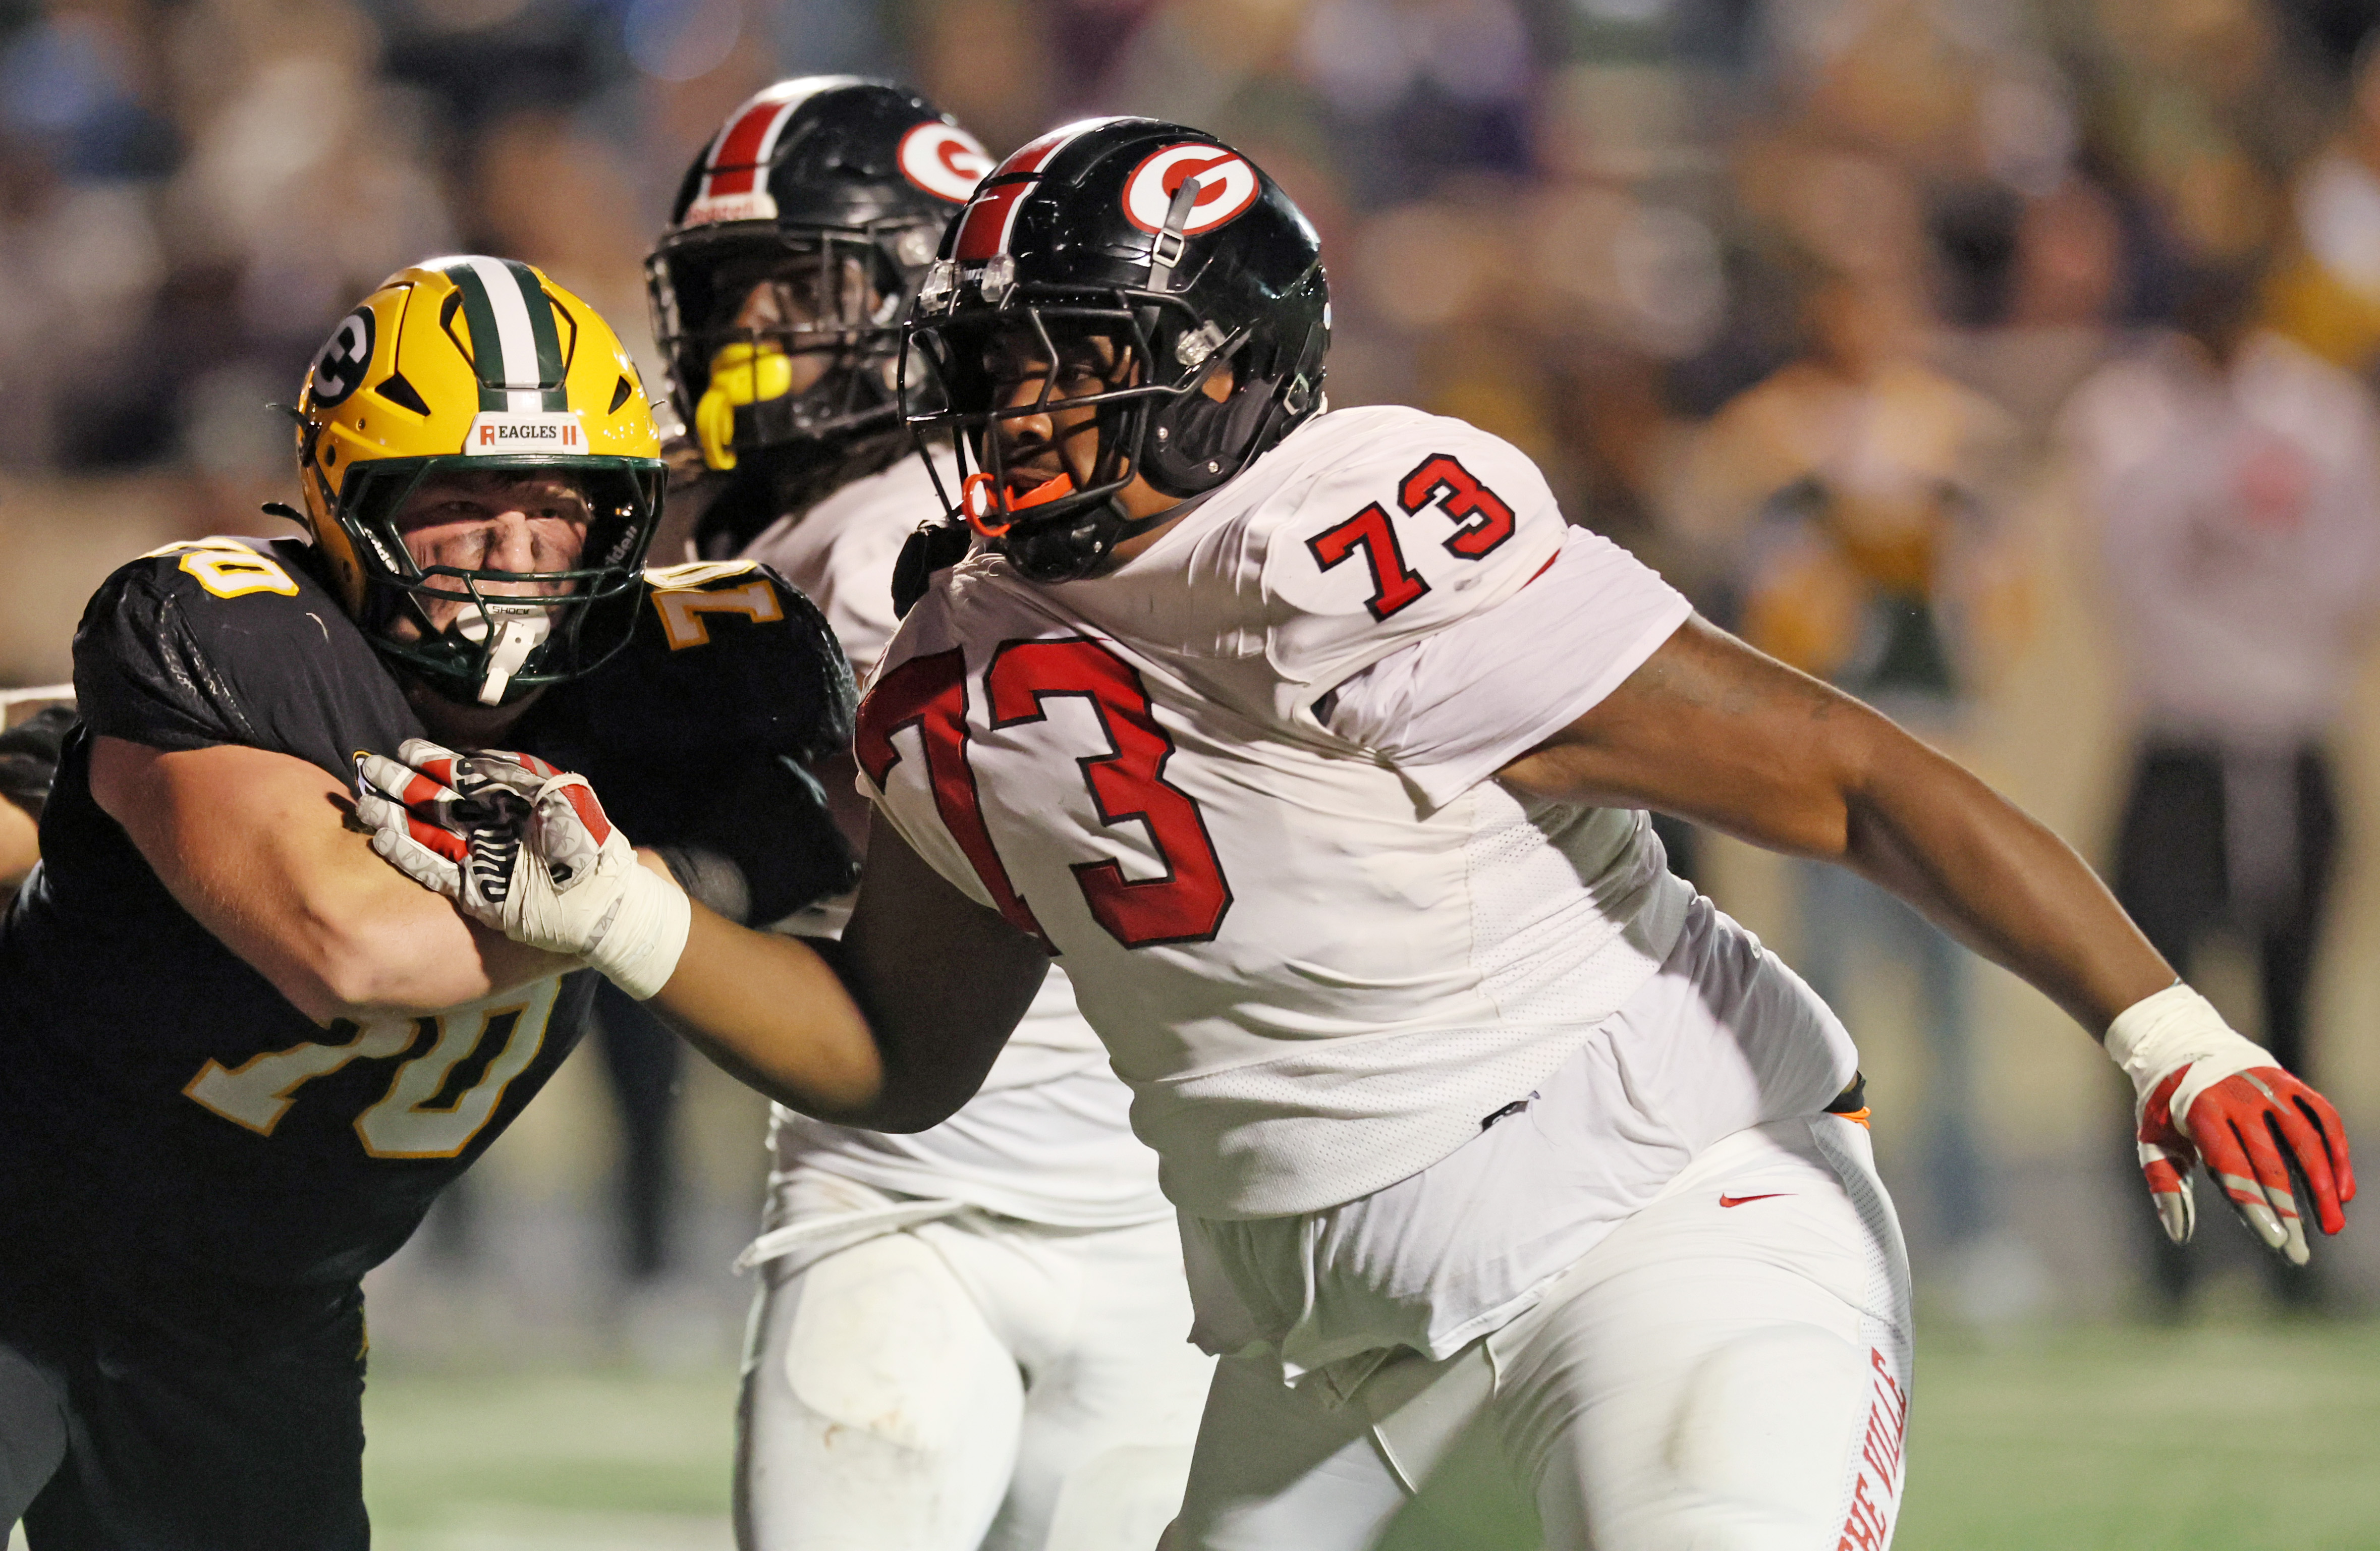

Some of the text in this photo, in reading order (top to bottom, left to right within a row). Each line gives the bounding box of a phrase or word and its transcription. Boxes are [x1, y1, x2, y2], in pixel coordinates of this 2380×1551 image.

[1125, 143, 1257, 234] G
[311, 314, 368, 398] C
[499, 425, 557, 438] EAGLES
[1304, 453, 1516, 624] 73
[852, 637, 1234, 957] 73
[1837, 1346, 1906, 1551] HE VILLE
